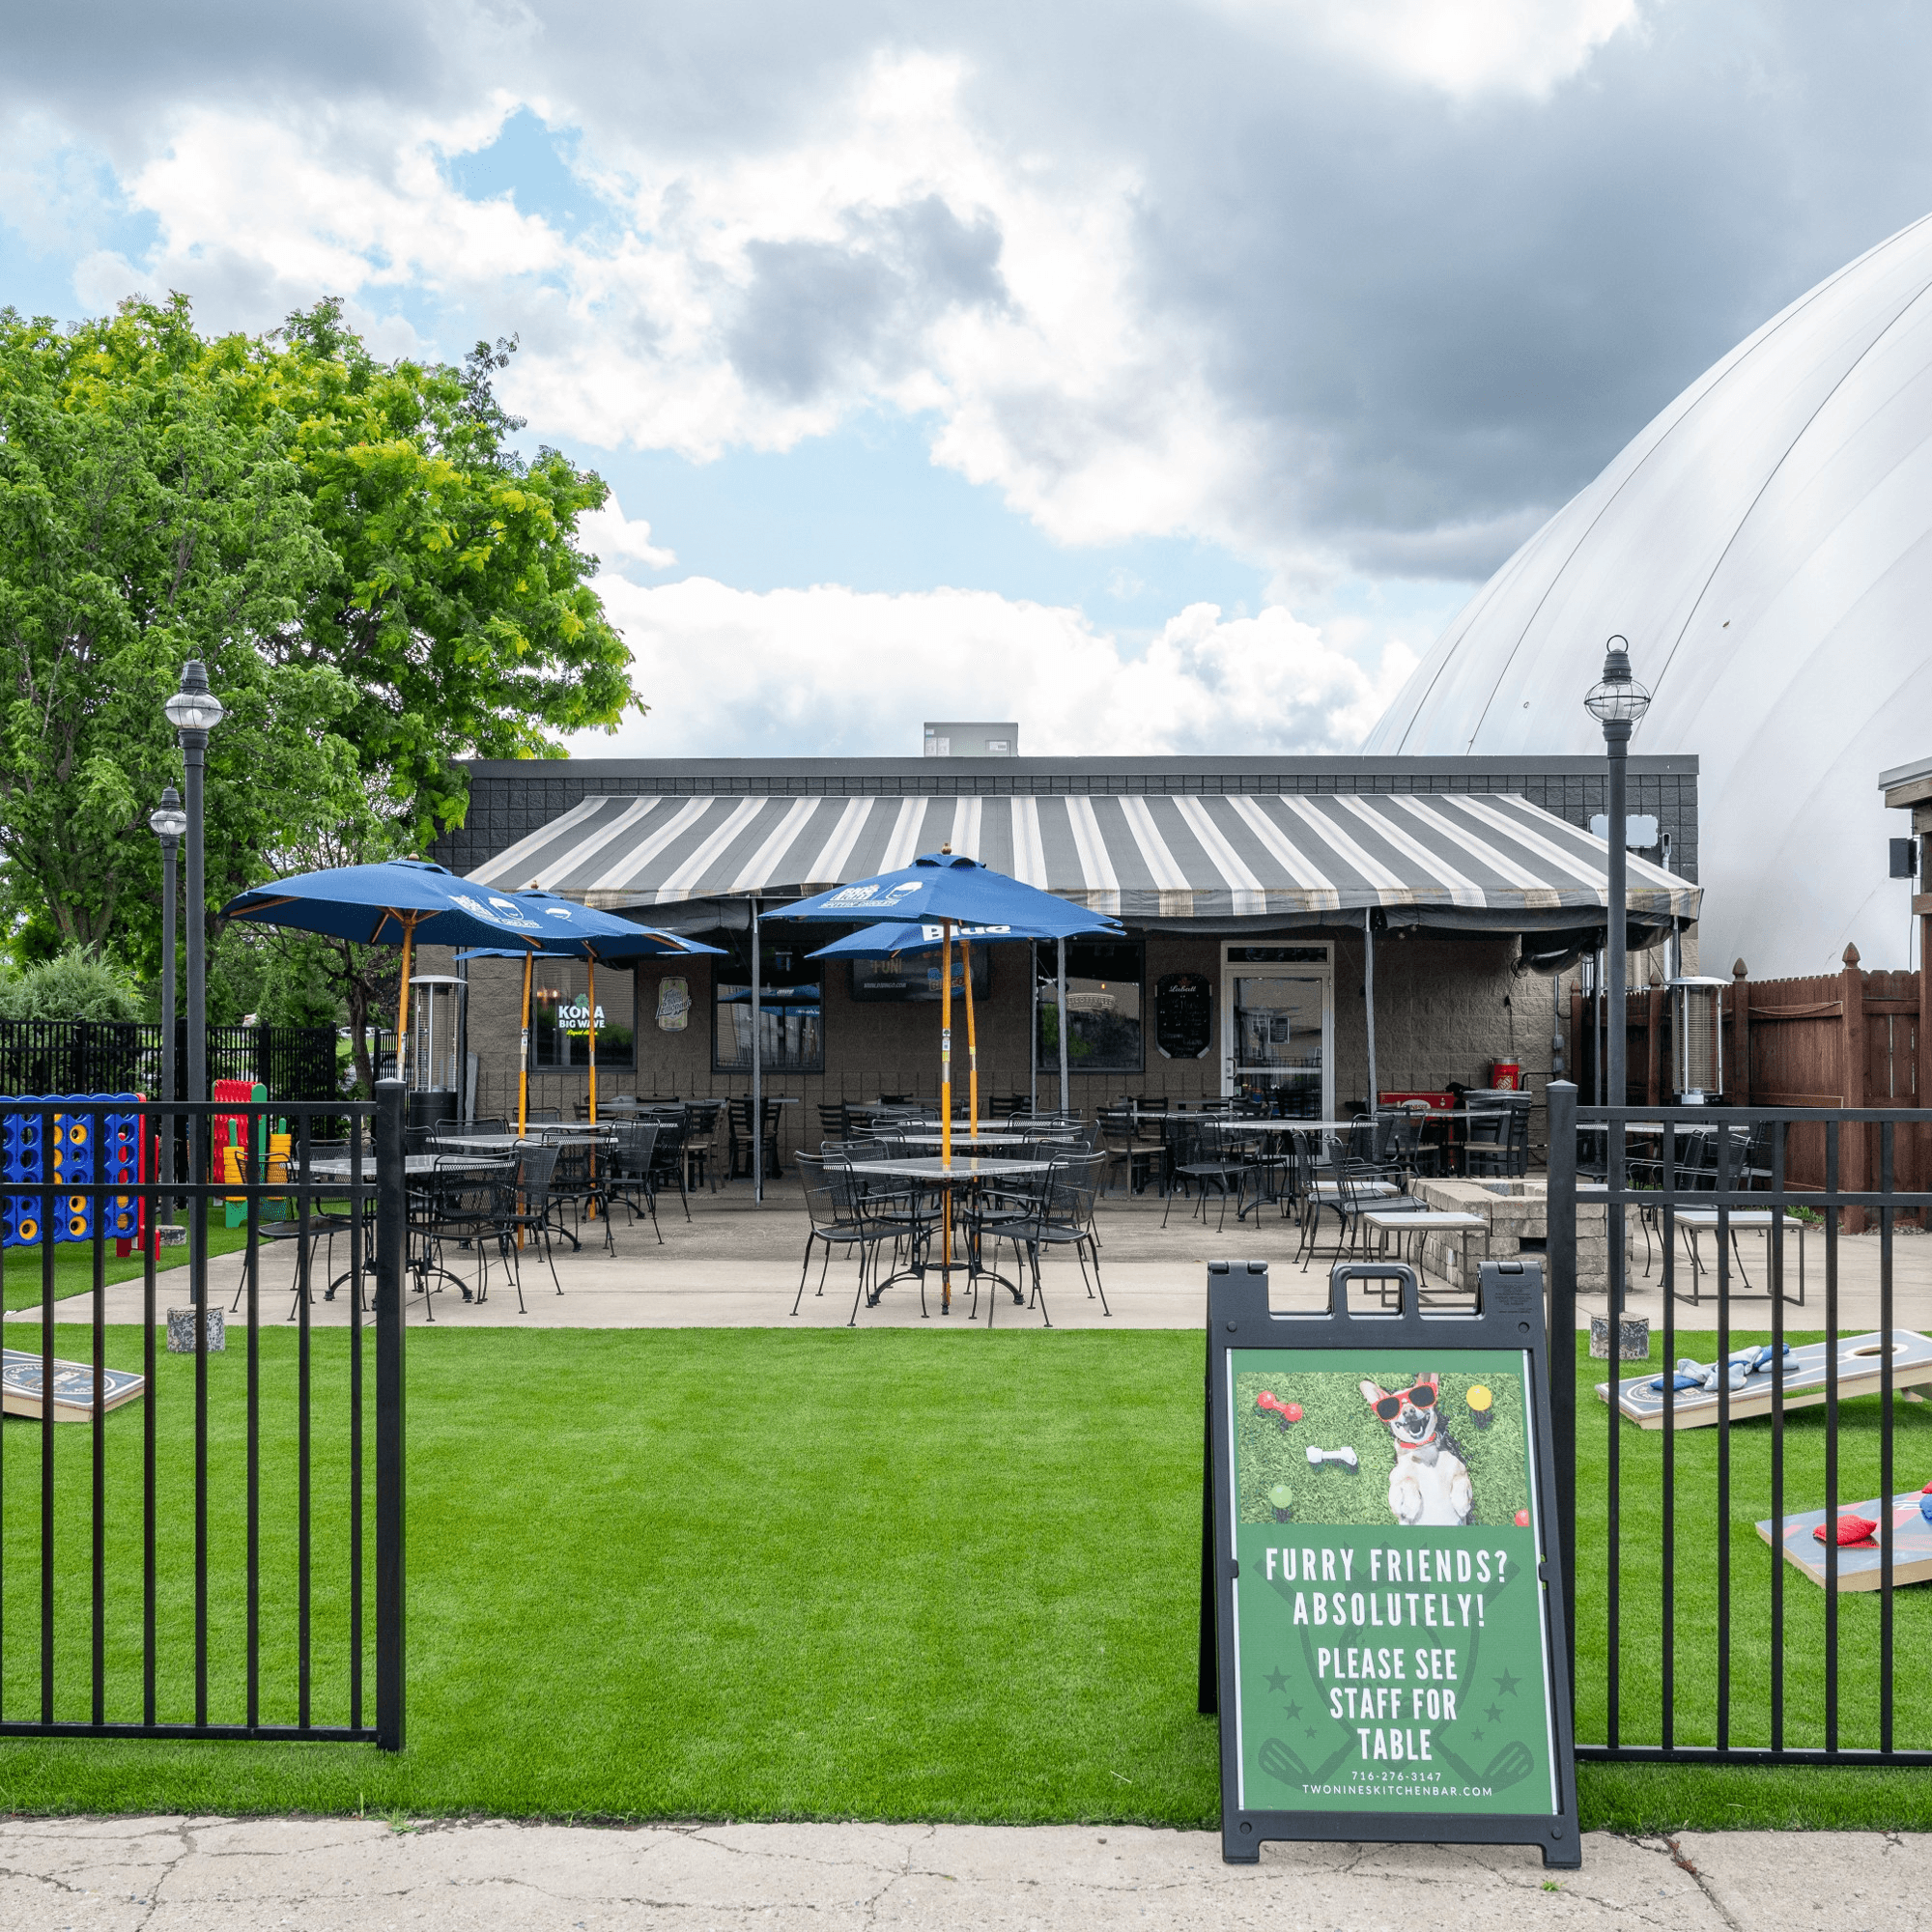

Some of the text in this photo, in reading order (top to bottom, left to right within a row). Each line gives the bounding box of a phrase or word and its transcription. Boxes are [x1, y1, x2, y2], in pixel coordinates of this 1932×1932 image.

[922, 924, 1011, 942] Blue
[1168, 984, 1197, 993] Labatt
[558, 1006, 605, 1019] KONA
[558, 1019, 576, 1029] BIG
[1265, 1548, 1508, 1583] FURRY FRIENDS?
[1293, 1592, 1486, 1627] ABSOLUTELY!
[1318, 1647, 1458, 1680] PLEASE SEE
[1329, 1687, 1457, 1720] STAFF FOR
[1357, 1727, 1433, 1760] TABLE
[1351, 1771, 1441, 1782] 716-276-3147
[1302, 1784, 1492, 1797] TWONINESKITCHENBAR.COM
